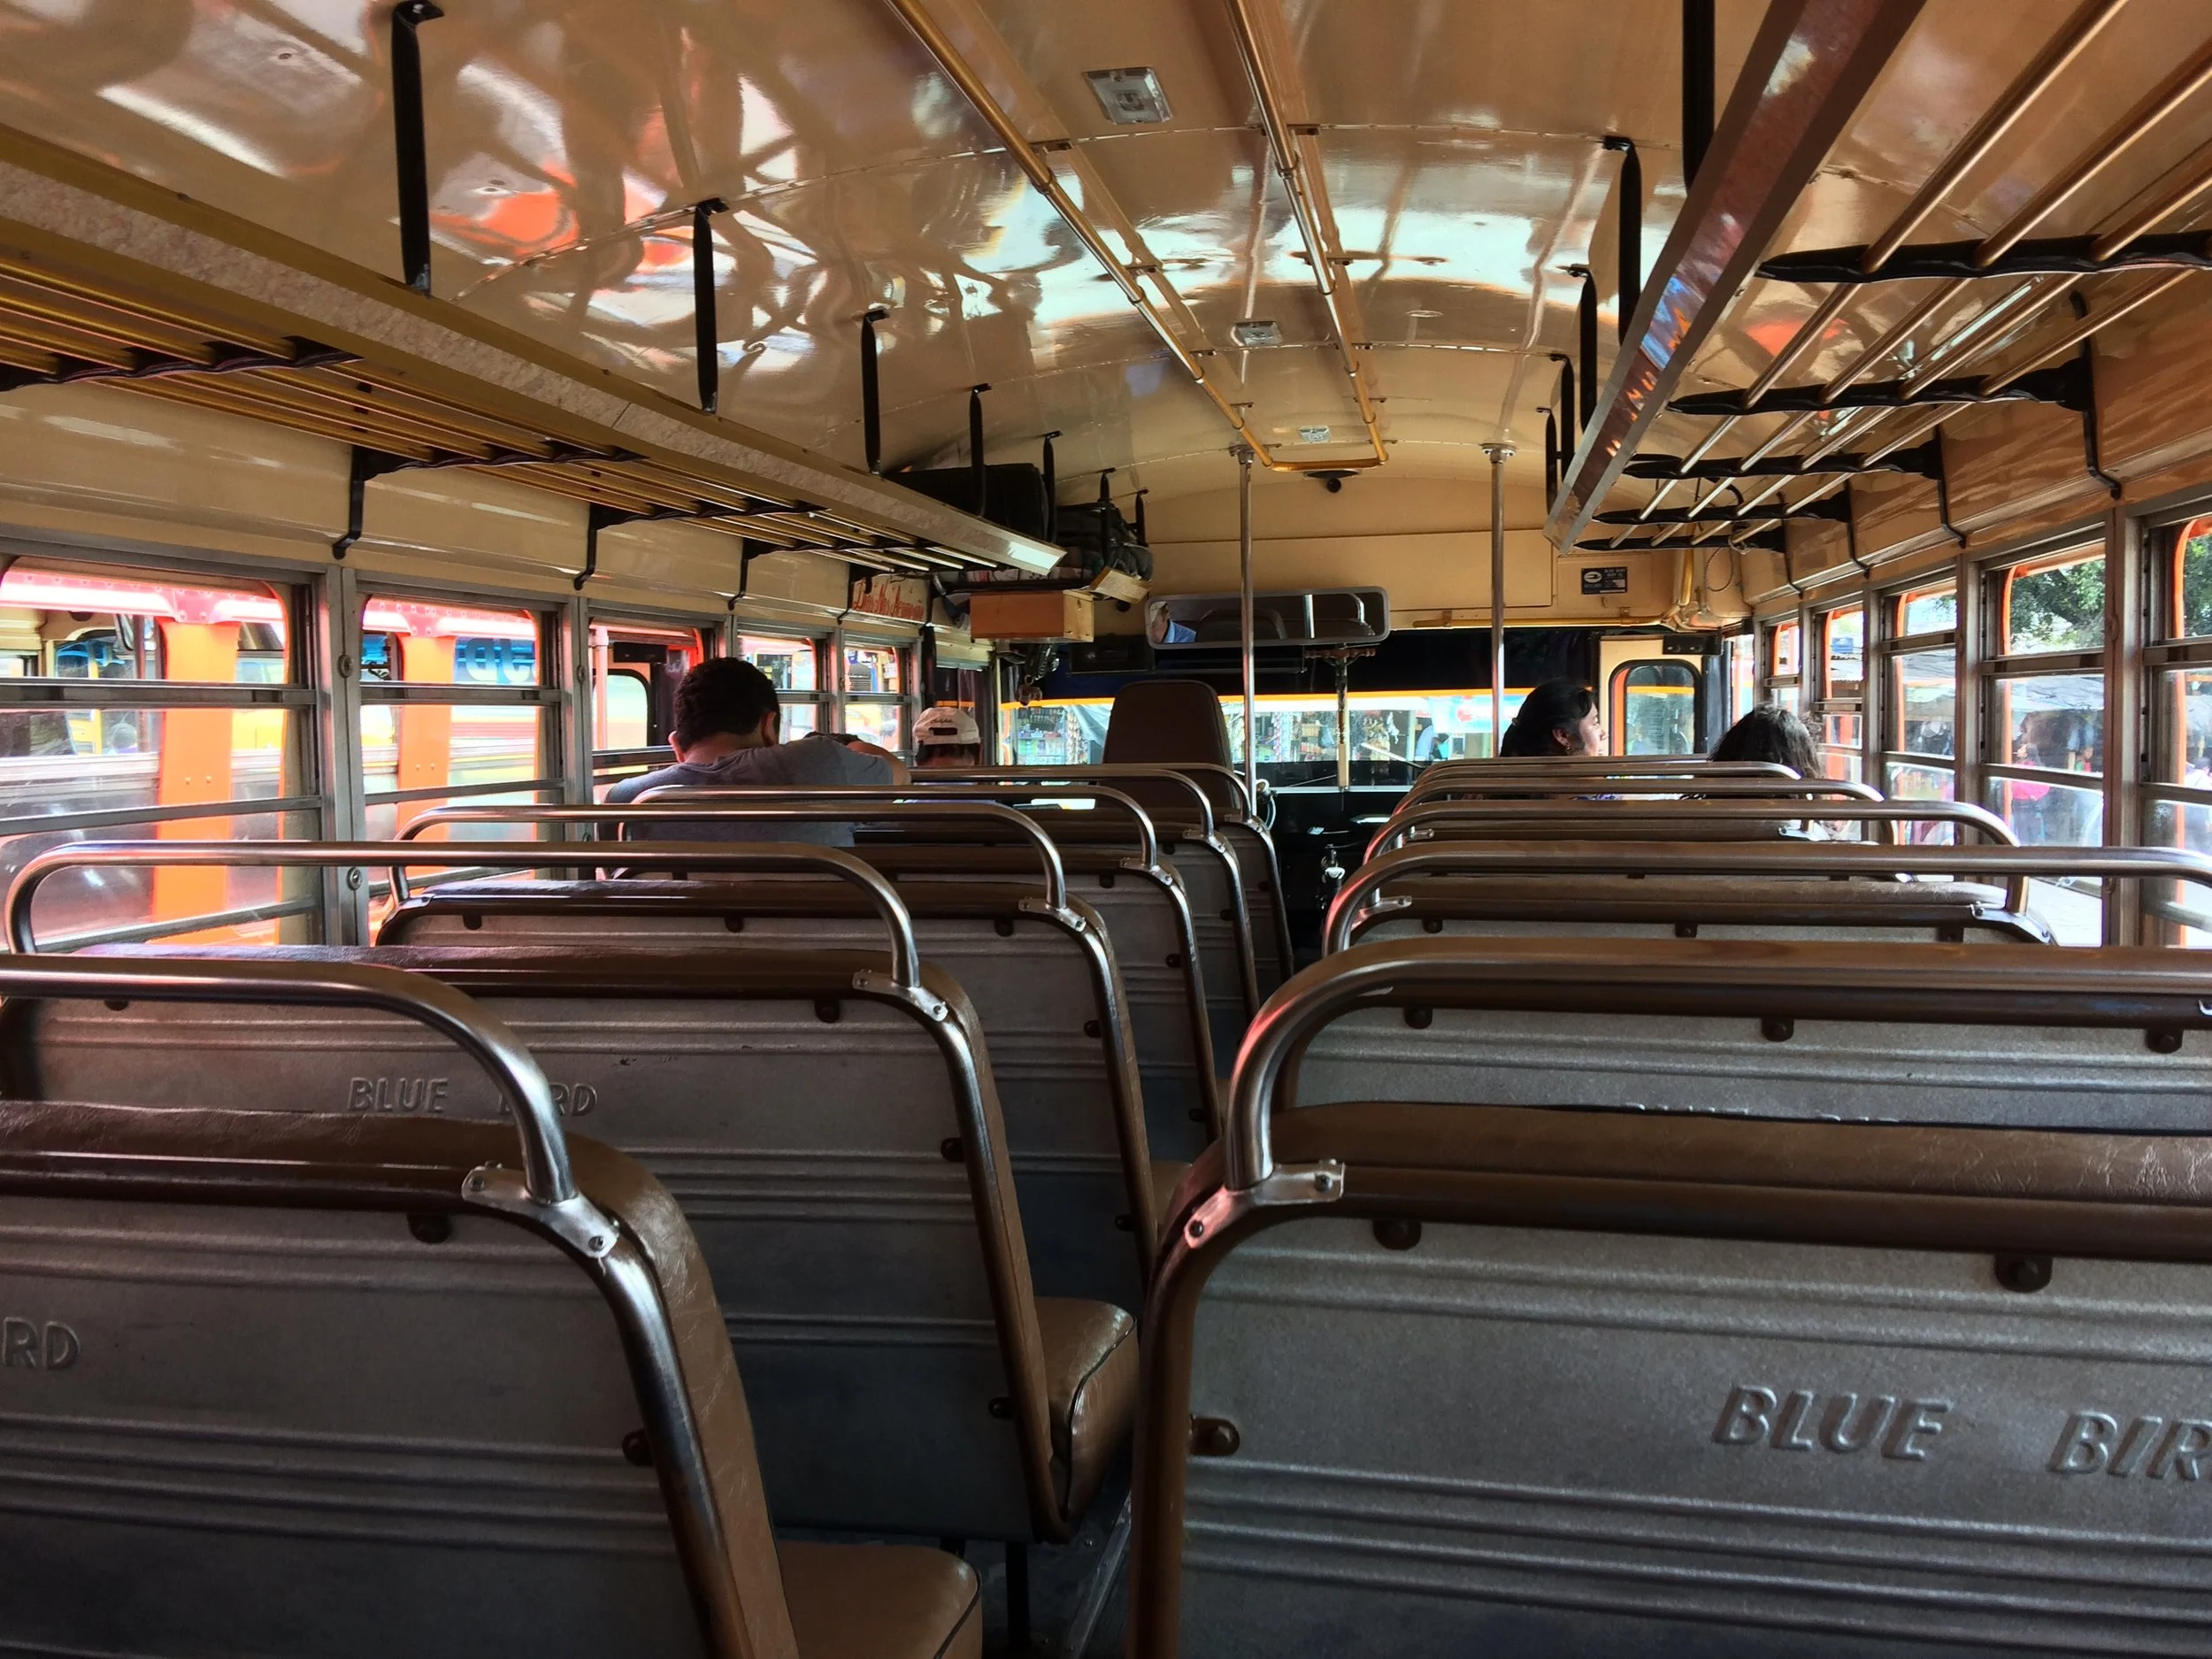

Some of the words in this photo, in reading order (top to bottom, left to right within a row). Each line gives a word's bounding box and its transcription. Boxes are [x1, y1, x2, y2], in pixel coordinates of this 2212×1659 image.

[346, 1076, 449, 1114] BLUE
[497, 1079, 599, 1118] RD
[1711, 1383, 1955, 1463] BLUE
[2045, 1409, 2212, 1483] BIR
